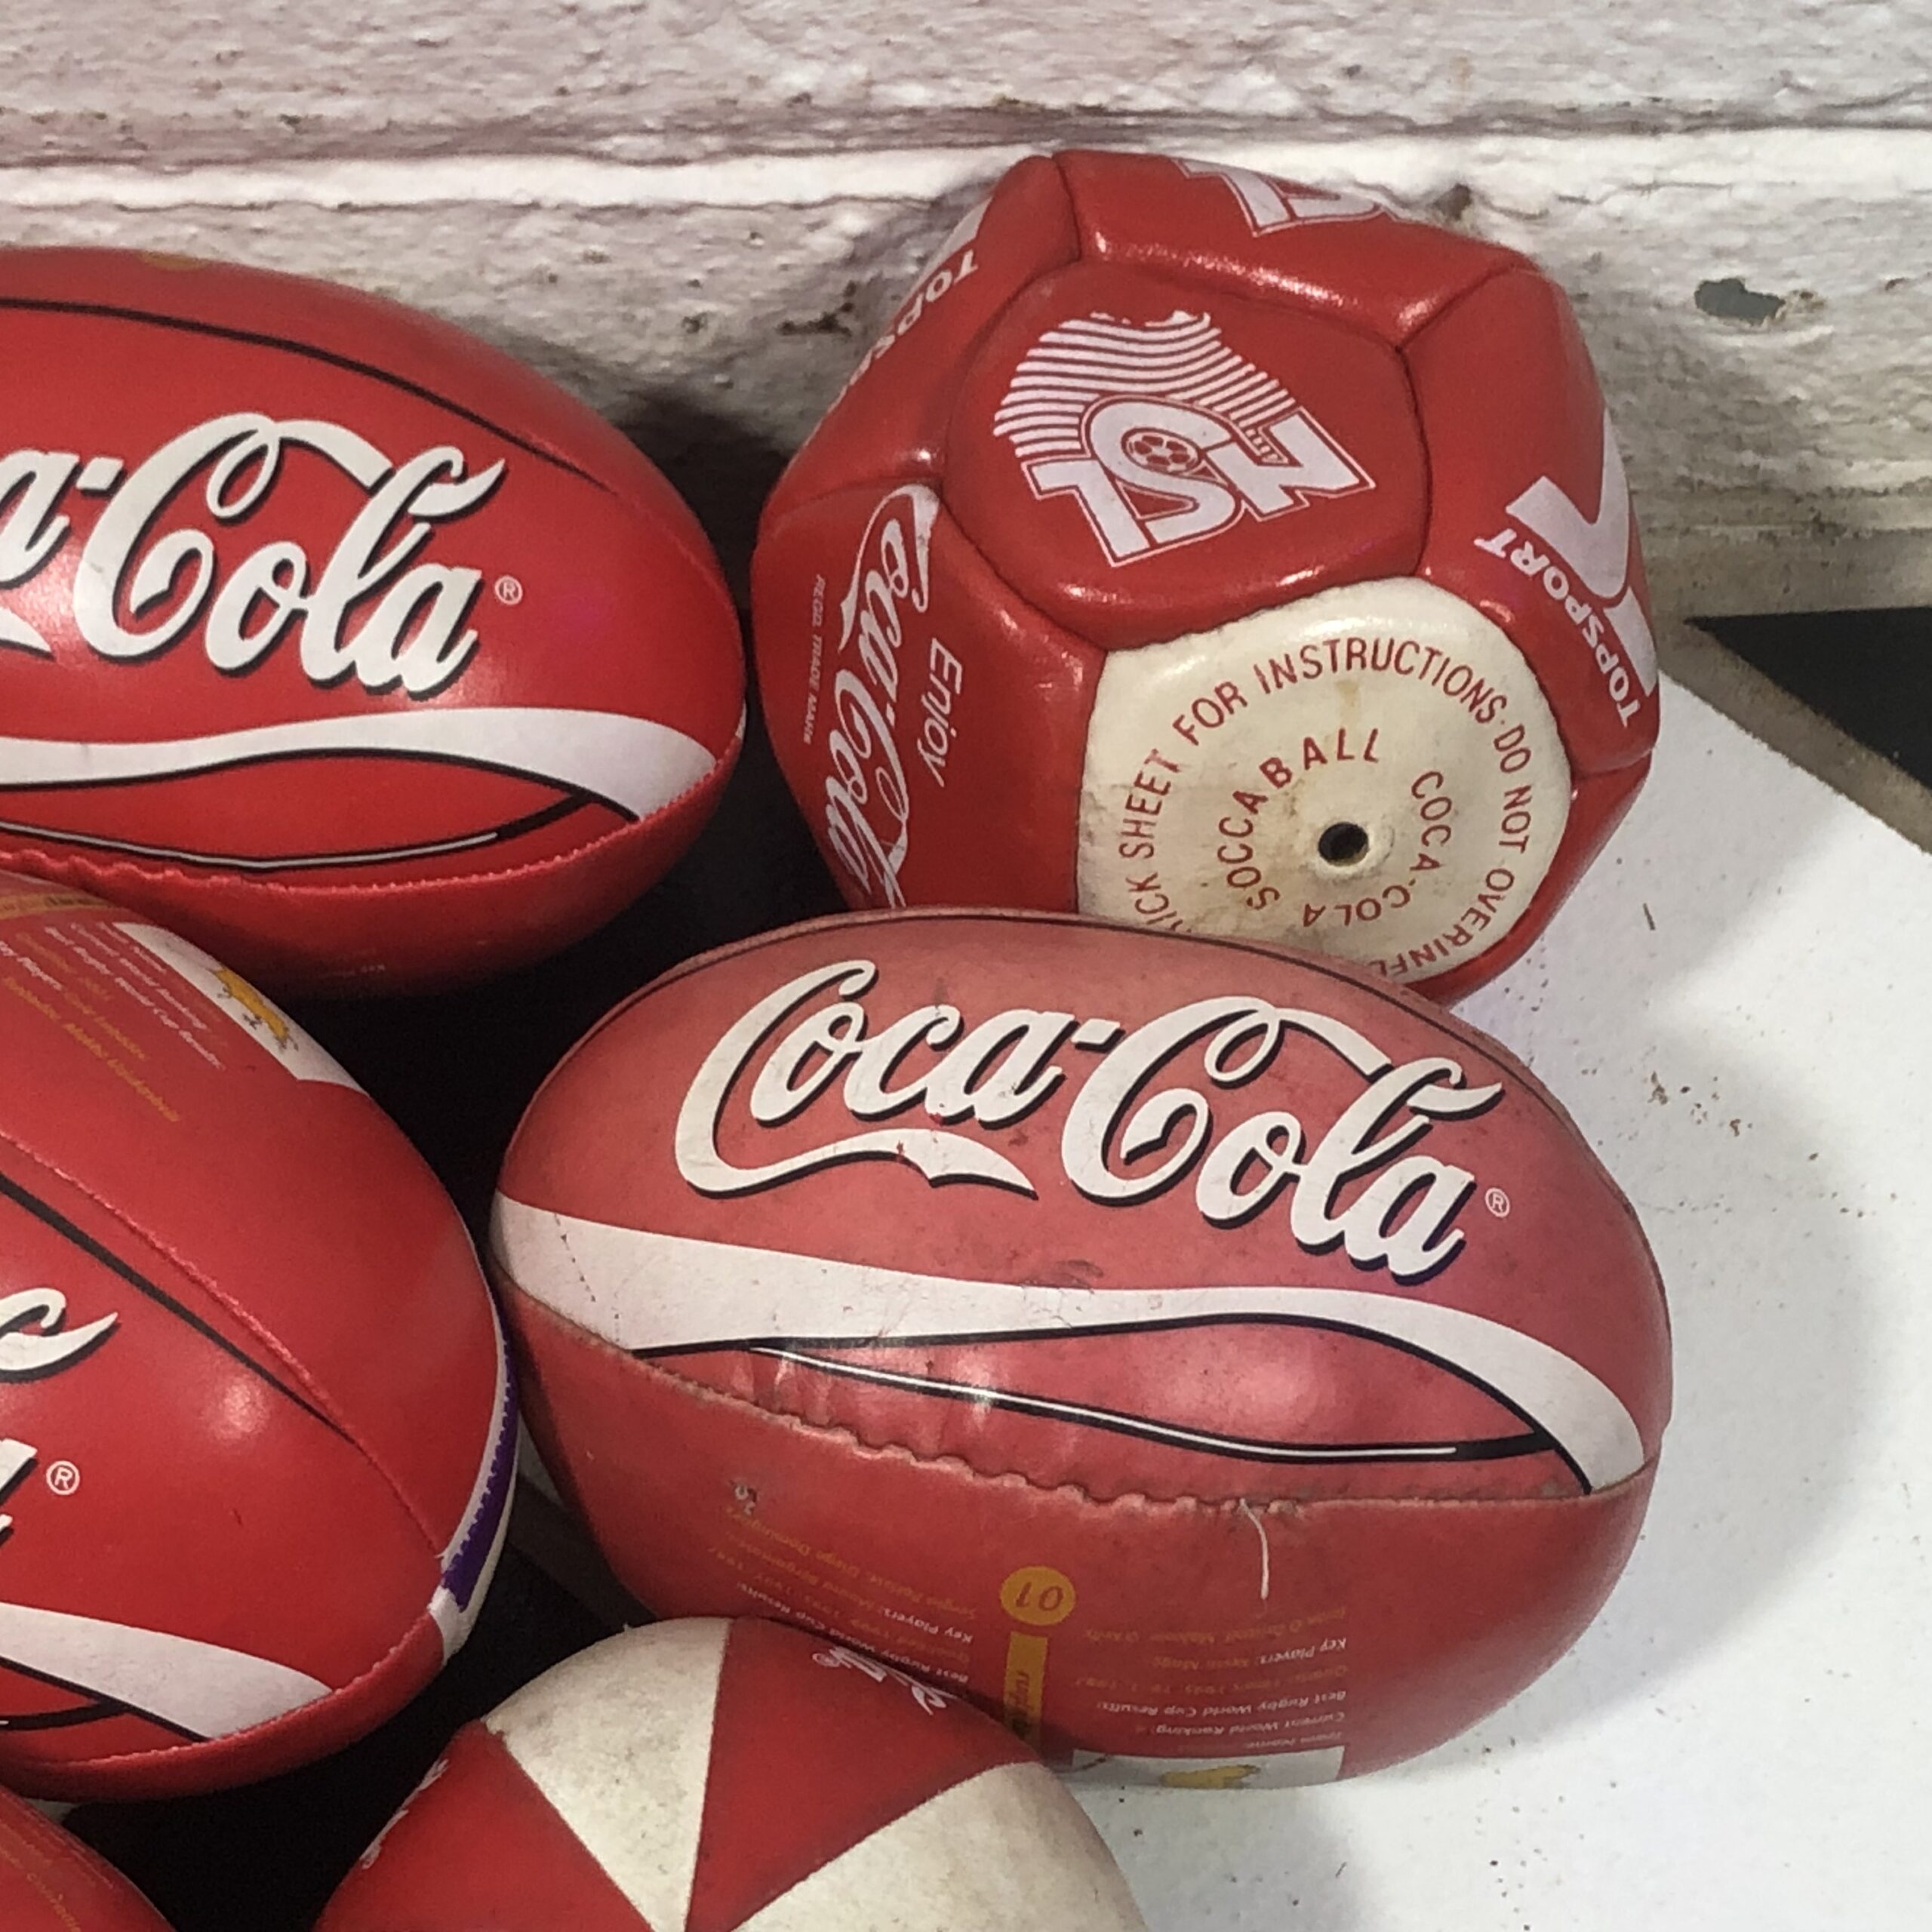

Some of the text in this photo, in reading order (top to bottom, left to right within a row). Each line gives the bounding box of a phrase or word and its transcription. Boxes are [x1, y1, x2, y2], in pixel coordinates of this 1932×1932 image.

[826, 483, 940, 909] Coca-Cola
[917, 638, 962, 787] Enjoy
[1473, 528, 1641, 728] TOPSPORT
[1119, 749, 1181, 859] SHEET
[1172, 681, 1247, 746] FOR
[1498, 786, 1532, 854] NOT
[675, 959, 1503, 1283] Coca-Cola
